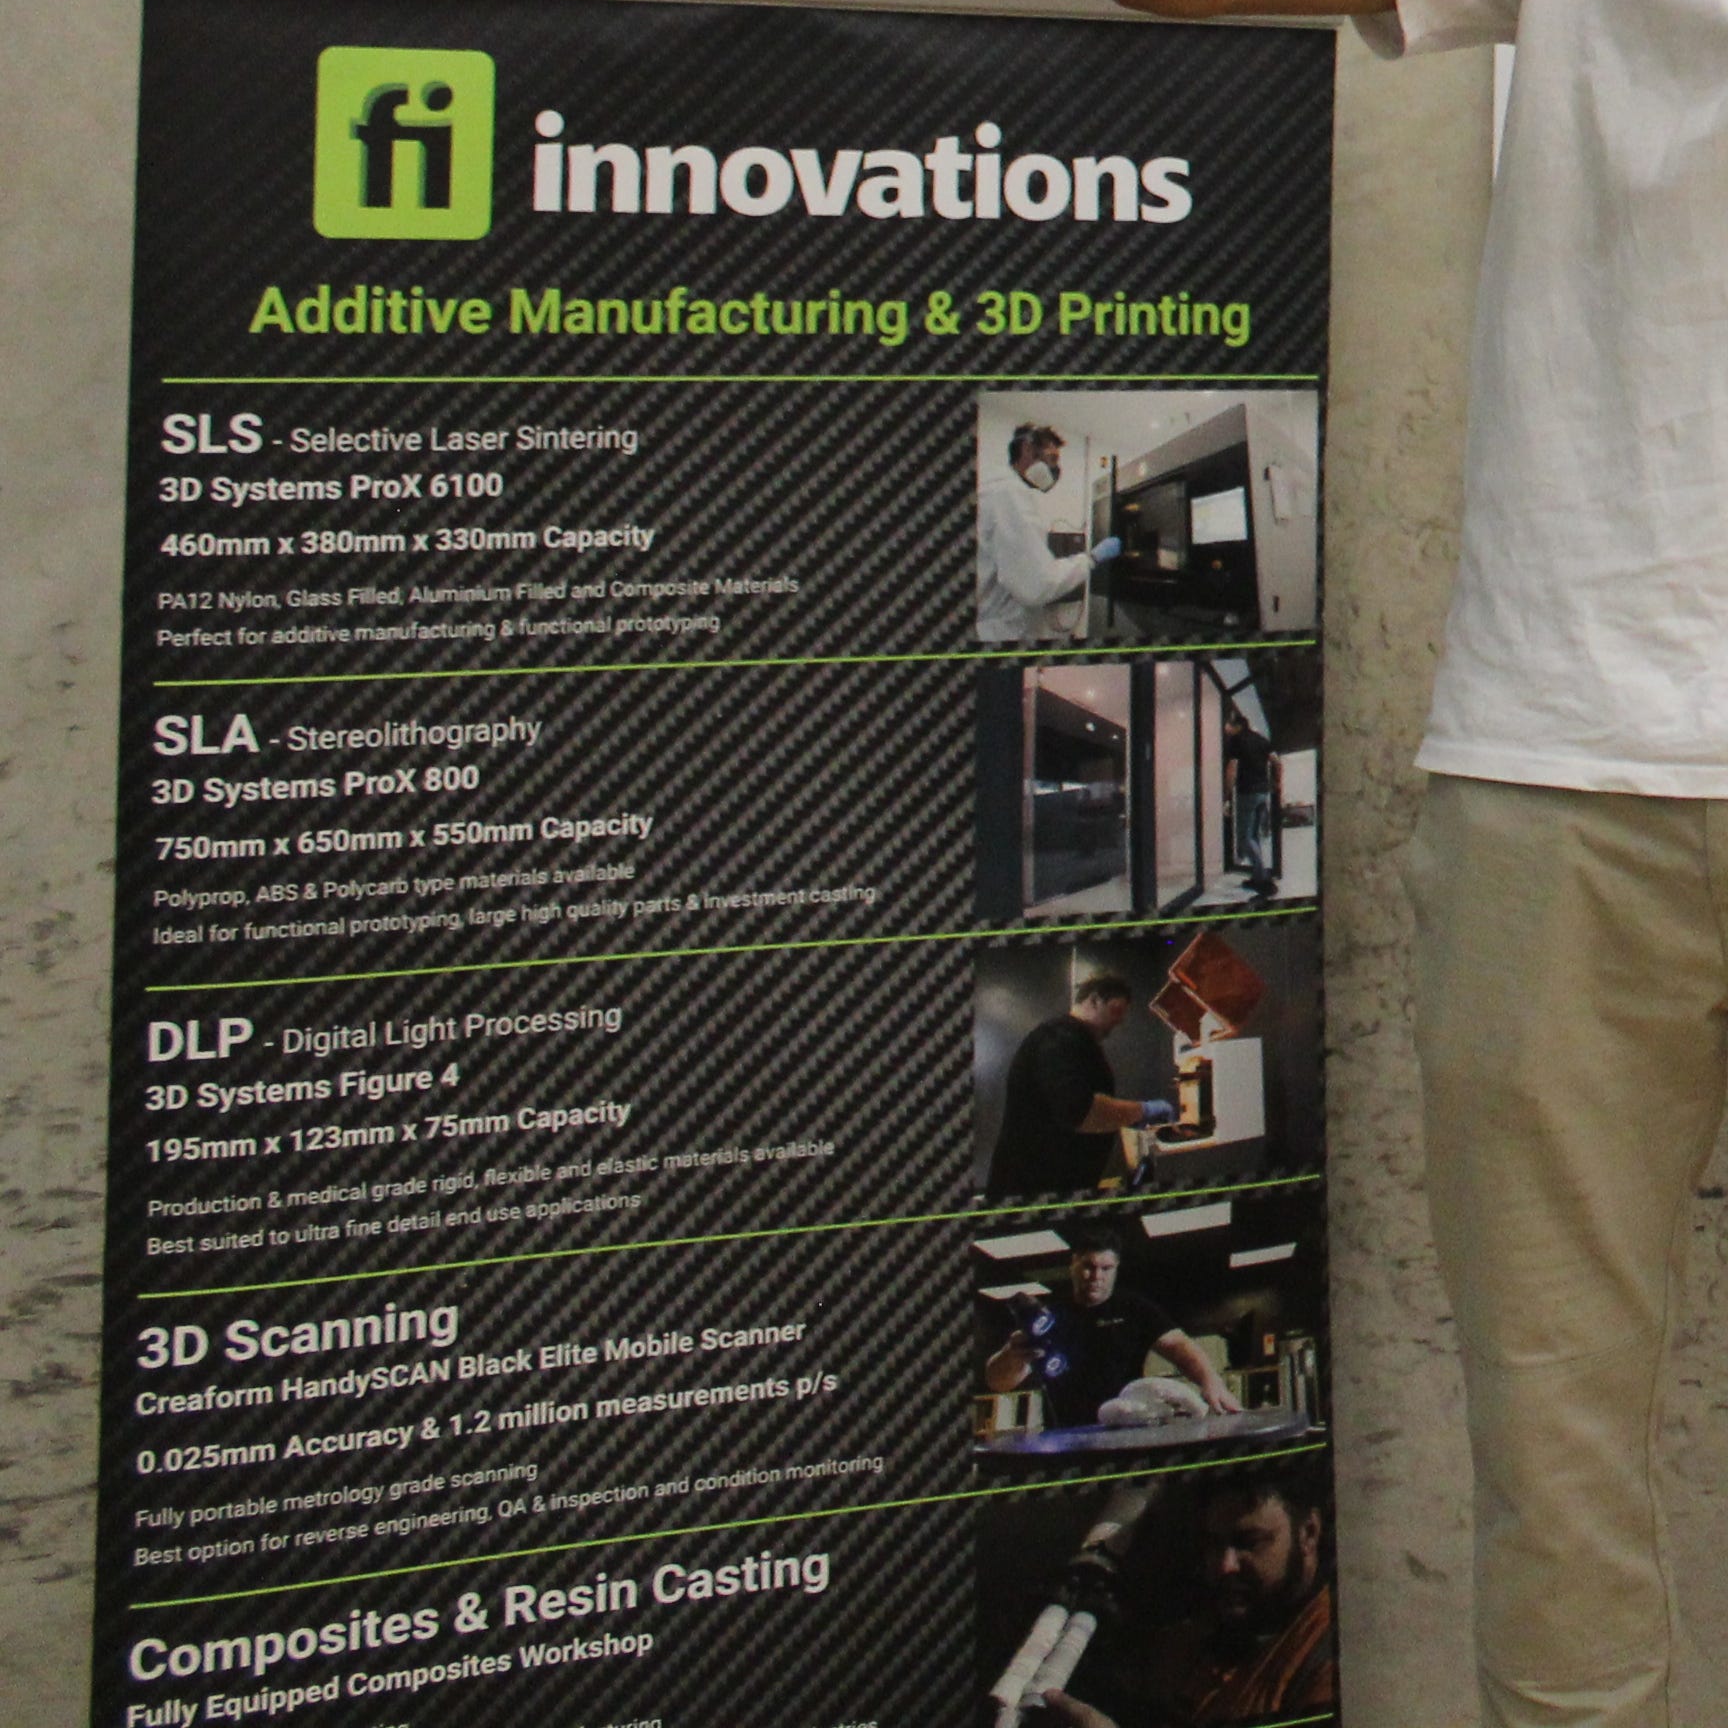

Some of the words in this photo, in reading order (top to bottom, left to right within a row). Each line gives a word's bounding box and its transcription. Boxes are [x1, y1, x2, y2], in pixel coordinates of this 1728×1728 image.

[349, 79, 455, 210] fi
[533, 110, 1193, 223] innovations
[250, 285, 491, 334] Additive
[509, 286, 908, 346] Manufacturing
[924, 291, 959, 335] &
[977, 291, 1043, 335] 3D
[1059, 291, 1250, 346] Printing
[161, 413, 263, 454] SLS
[290, 427, 422, 453] Selective
[431, 427, 509, 451] Laser
[516, 426, 639, 454] Sintering
[159, 477, 201, 503] 3D
[209, 476, 342, 508] Systems
[350, 473, 422, 500] ProX
[430, 473, 504, 498] 6100
[161, 533, 270, 556] 460mm
[277, 536, 294, 555] x
[301, 531, 406, 554] 380mm
[412, 534, 429, 551] x
[436, 528, 536, 551] 330mm
[543, 525, 655, 552] Capacity
[154, 714, 261, 756] SLA
[286, 716, 542, 752] Stereolithography
[151, 779, 194, 804] 3D
[202, 776, 336, 808] Systems
[344, 768, 416, 796] ProX
[424, 765, 480, 792] 800
[155, 836, 266, 861] 750mm
[272, 838, 291, 855] x
[297, 830, 401, 854] 650mm
[409, 830, 426, 848] x
[432, 821, 533, 846] 550mm
[540, 813, 654, 842] Capacity
[149, 1018, 253, 1062] DLP
[282, 1021, 376, 1057] Digital
[384, 1016, 457, 1049] Light
[464, 1006, 623, 1038] Processing
[146, 1084, 189, 1111] 3D
[197, 1078, 331, 1113] Systems
[340, 1069, 432, 1100] Figure
[440, 1063, 460, 1087] 4
[137, 1325, 209, 1369] 3D
[224, 1303, 459, 1361] Scanning
[136, 1385, 272, 1416] Creaform
[281, 1359, 450, 1401] HandySCAN
[458, 1348, 532, 1379] Black
[539, 1344, 598, 1370] Elite
[604, 1331, 694, 1361] Mobile
[700, 1321, 807, 1352] Scanner
[137, 1443, 276, 1474] 0.025mm
[282, 1424, 414, 1460] Accuracy
[421, 1417, 440, 1440] &
[450, 1410, 492, 1436] 1.2
[499, 1401, 588, 1431] million
[595, 1377, 790, 1419] measurements
[796, 1371, 838, 1400] p/s
[134, 1510, 185, 1530] Fully
[189, 1498, 277, 1527] portable
[282, 1483, 384, 1512] metrology
[389, 1474, 446, 1501] grade
[450, 1462, 538, 1488] scanning
[129, 1607, 439, 1682] Composites
[453, 1591, 489, 1634] &
[504, 1573, 638, 1627] Resin
[652, 1550, 830, 1605] Casting
[126, 1698, 198, 1728] Fully
[206, 1676, 340, 1720] Equipped
[348, 1653, 512, 1696] Composites
[519, 1631, 654, 1669] Workshop
